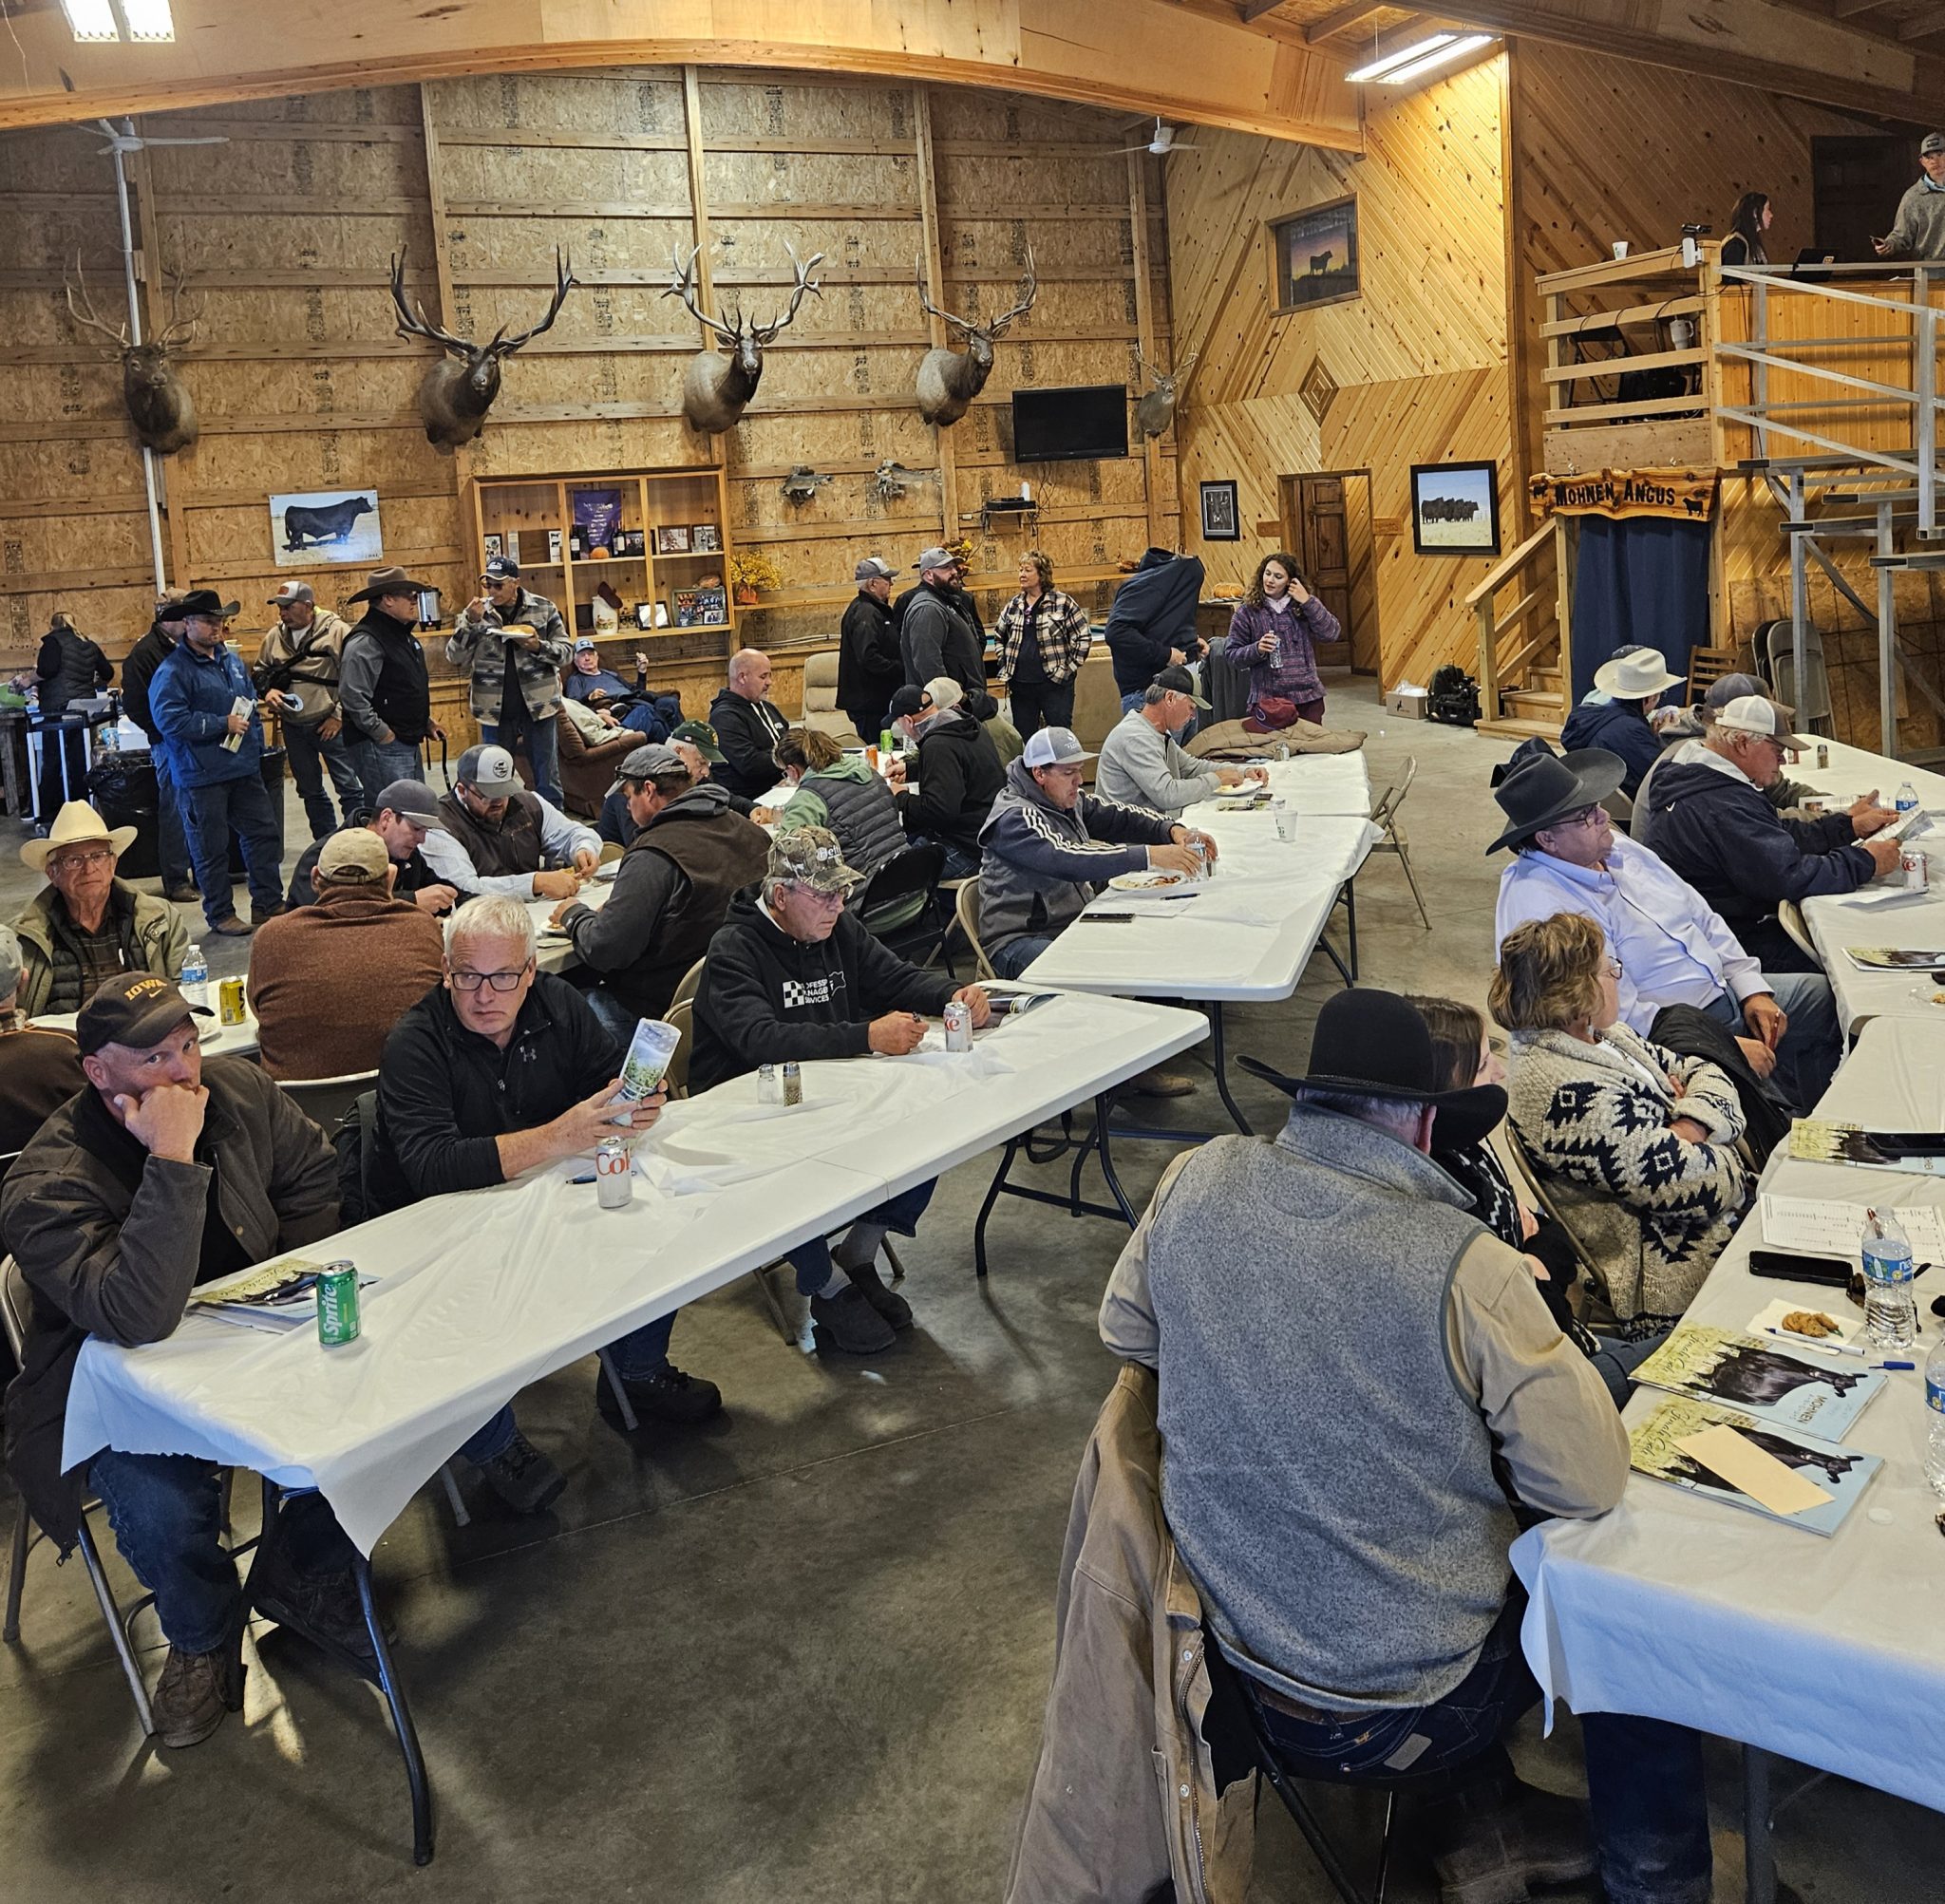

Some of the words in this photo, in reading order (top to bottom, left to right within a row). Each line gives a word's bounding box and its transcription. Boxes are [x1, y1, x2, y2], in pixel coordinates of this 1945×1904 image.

[1555, 482, 1615, 506] MOHNEN
[1624, 479, 1675, 505] ANGUS
[124, 979, 168, 1001] IOWA
[322, 1284, 343, 1336] Sprite
